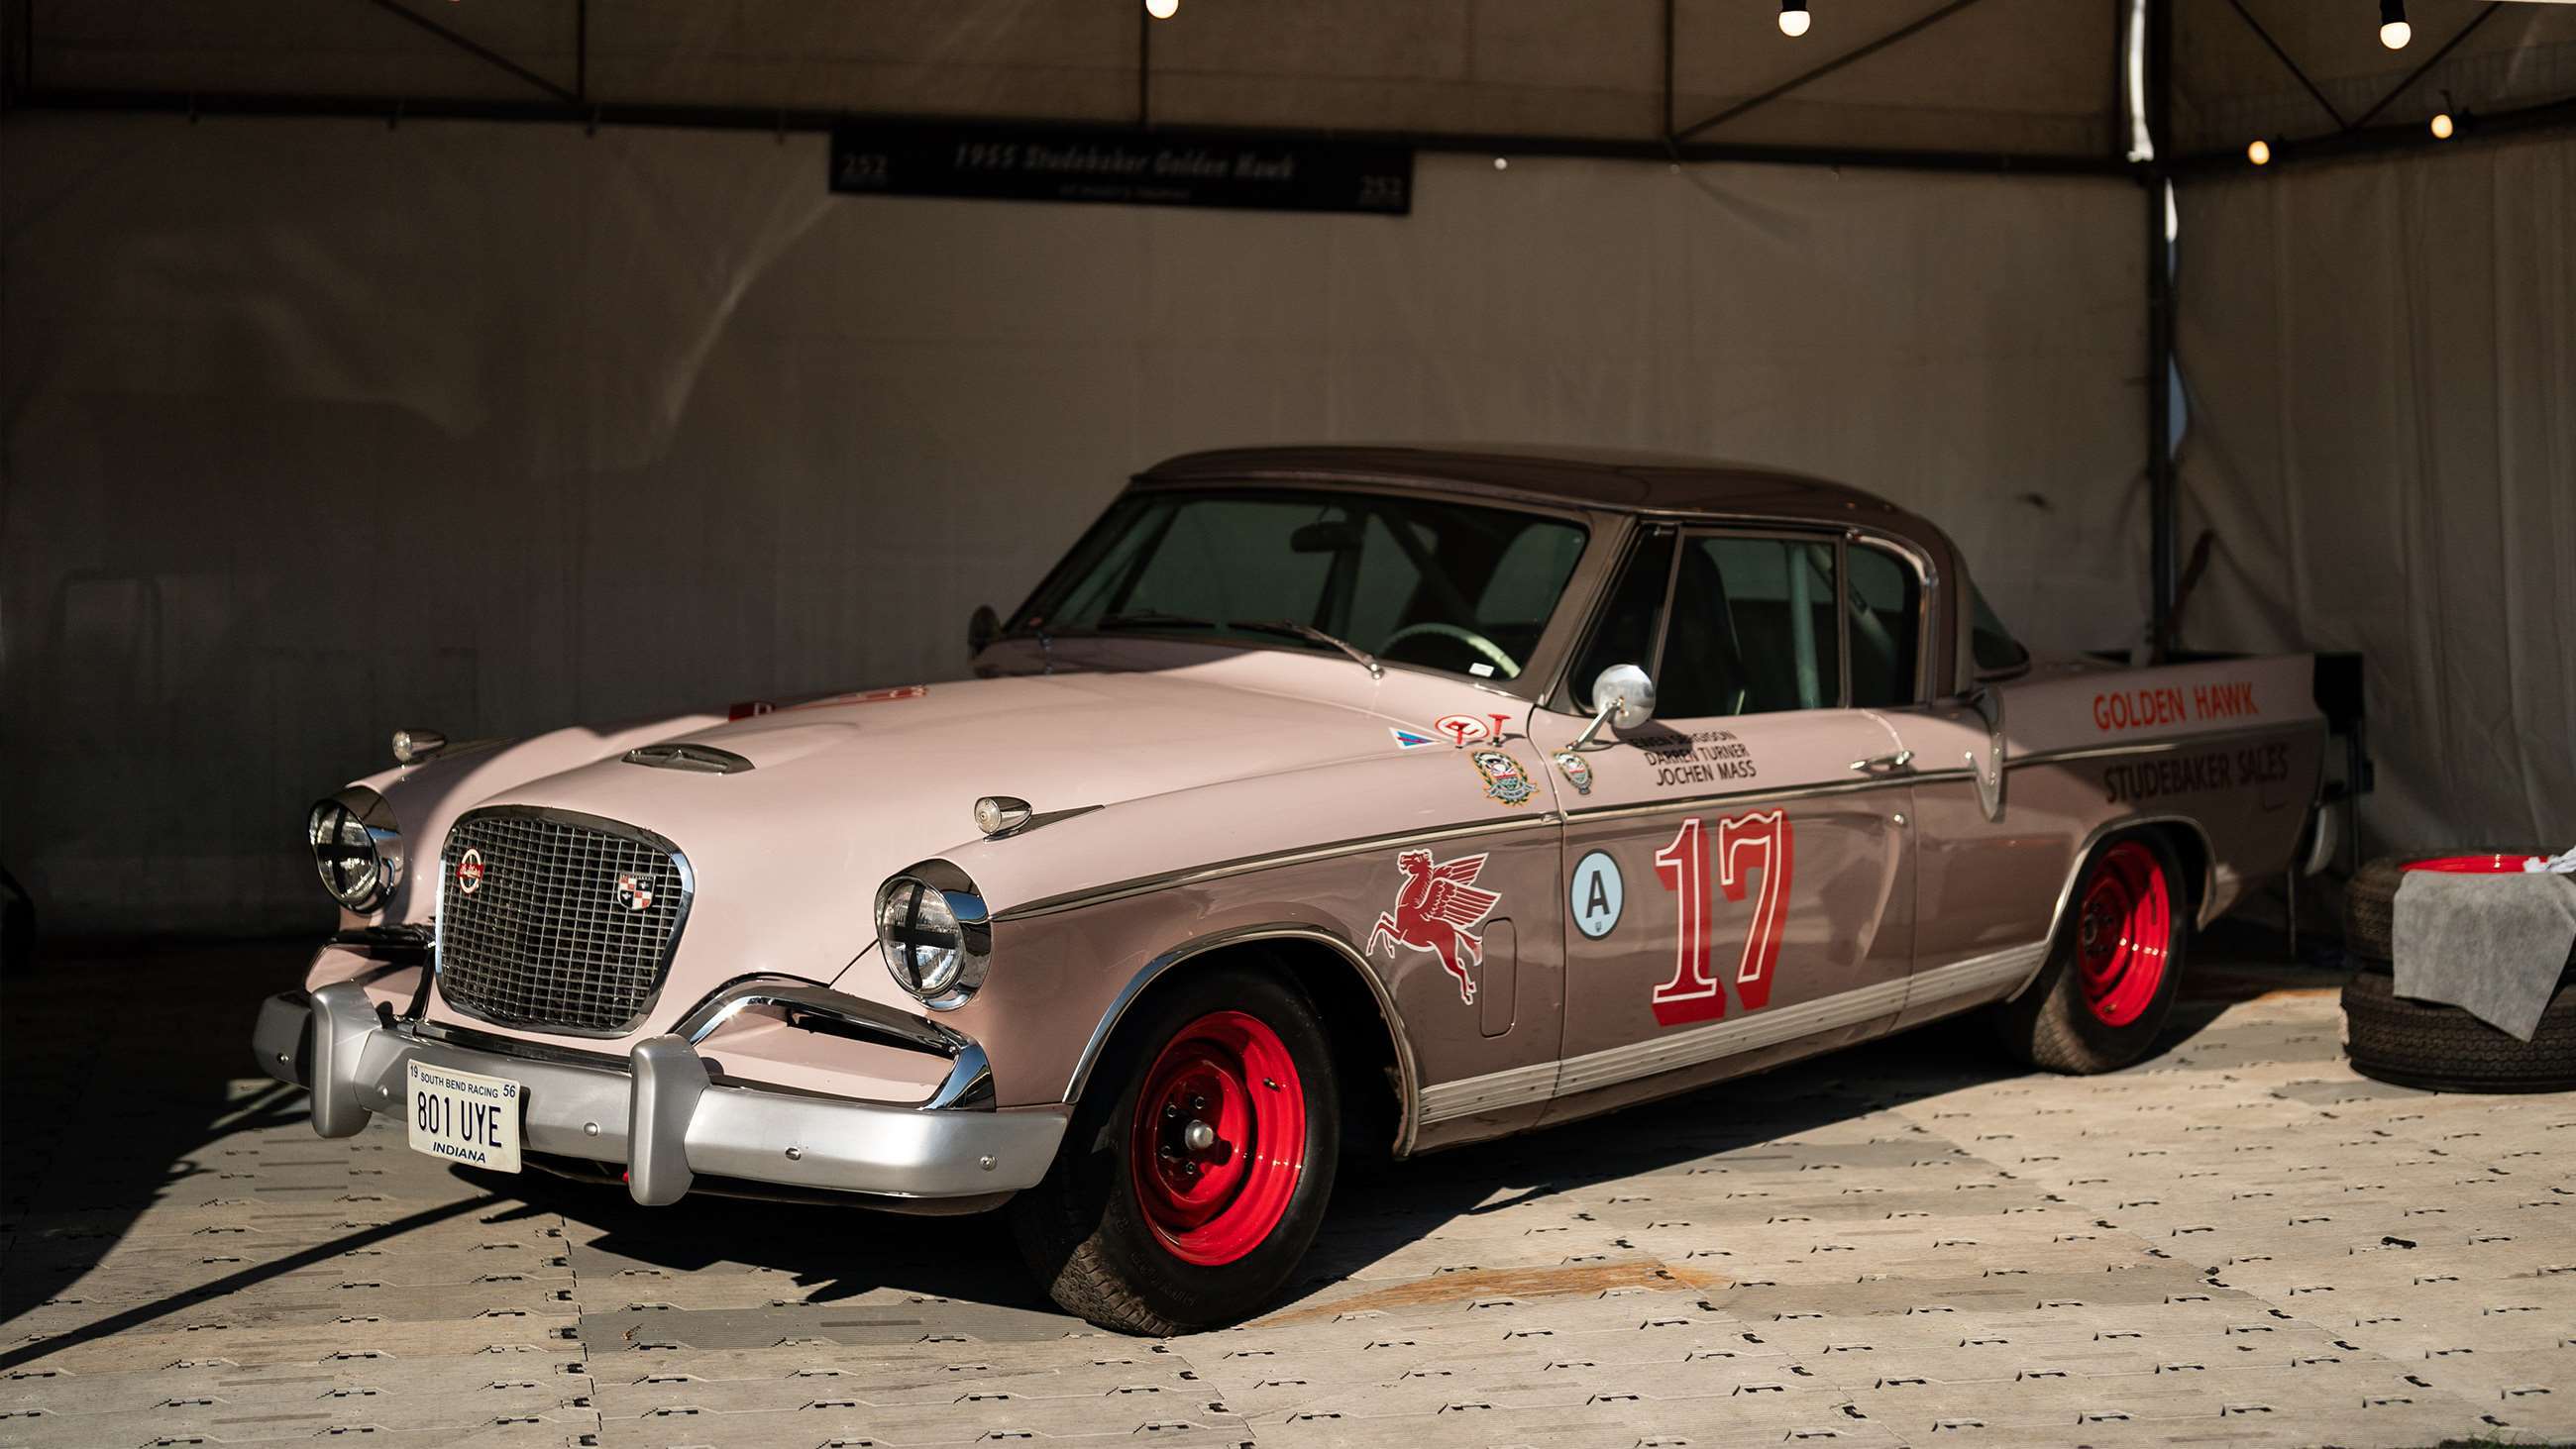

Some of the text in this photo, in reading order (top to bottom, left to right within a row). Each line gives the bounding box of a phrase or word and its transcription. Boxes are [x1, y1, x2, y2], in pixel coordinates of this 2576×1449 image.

[2093, 681, 2259, 730] GOLDEN HAWK
[1657, 760, 1758, 786] JOCHEN MASS
[1697, 743, 1751, 762] TURNER
[2103, 744, 2290, 803] STUDEBAKER SALES
[1586, 870, 1610, 918] A
[1652, 807, 1794, 1026] 17
[410, 1065, 516, 1098] 19 SOUTH BEND RACING 56
[417, 1090, 502, 1148] 801 UYE
[432, 1141, 487, 1164] INDIANA
